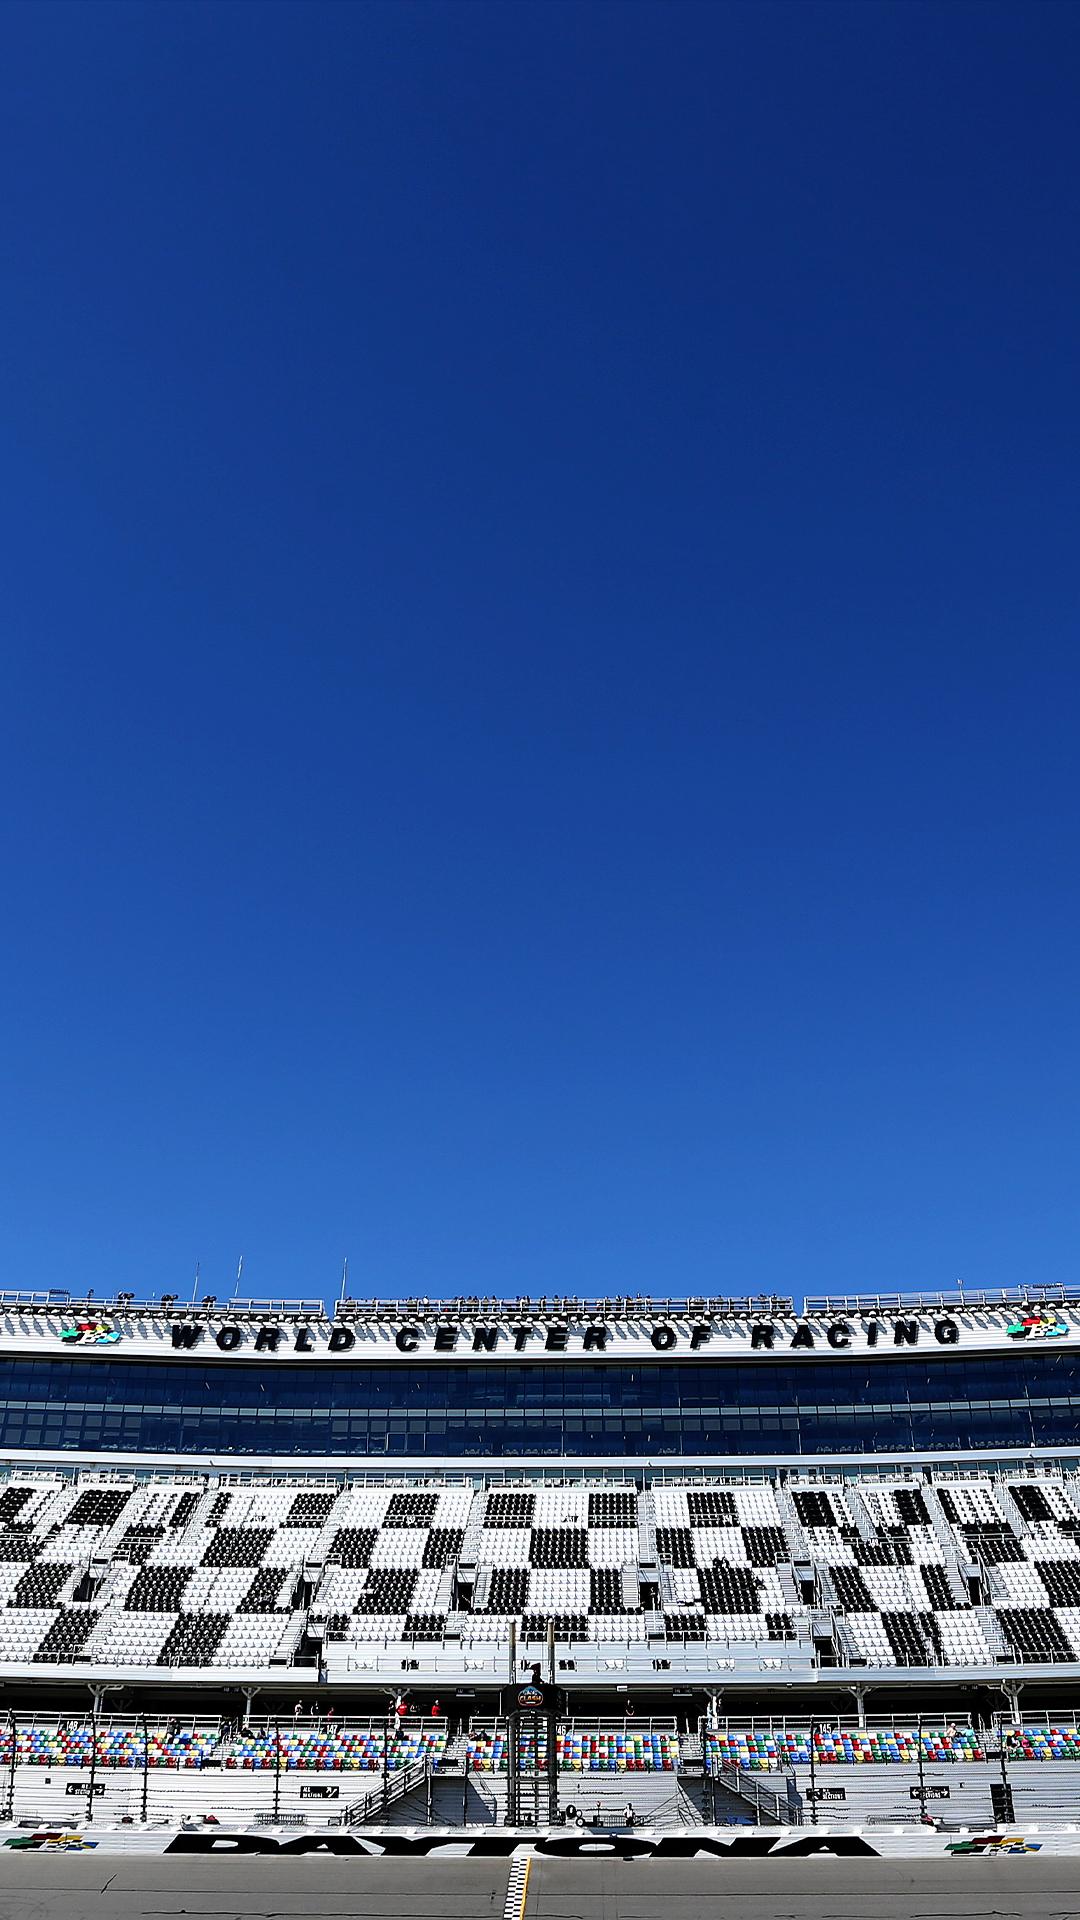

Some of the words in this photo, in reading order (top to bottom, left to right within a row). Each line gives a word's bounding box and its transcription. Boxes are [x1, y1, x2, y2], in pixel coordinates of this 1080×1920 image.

[171, 1324, 353, 1351] WORLD
[395, 1326, 607, 1352] CENTER
[650, 1326, 711, 1351] OF
[750, 1319, 959, 1350] RACING
[66, 1720, 79, 1731] 148
[326, 1724, 339, 1734] 147
[819, 1723, 832, 1734] 145
[163, 1834, 882, 1857] DAYTONA
